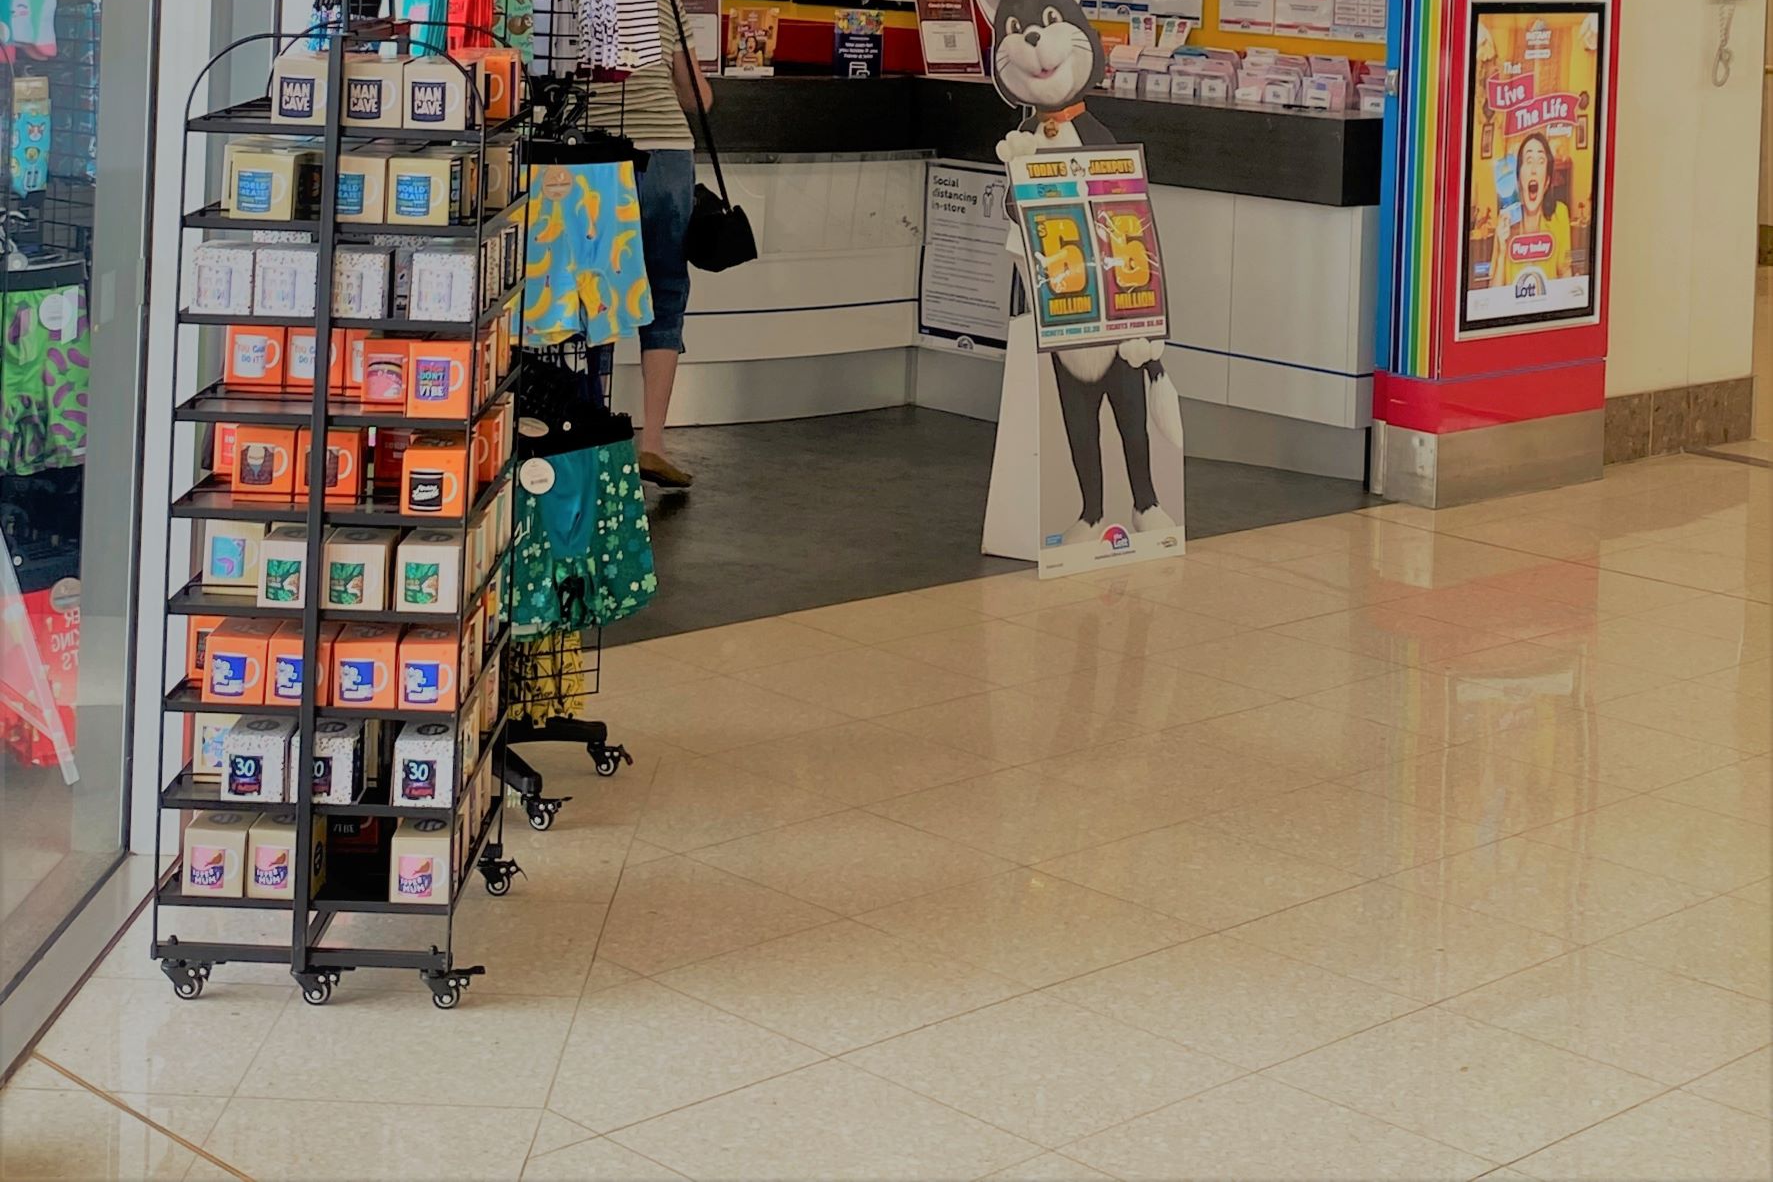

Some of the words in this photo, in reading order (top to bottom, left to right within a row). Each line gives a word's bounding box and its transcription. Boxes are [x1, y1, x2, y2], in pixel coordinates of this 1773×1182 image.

[282, 82, 311, 97] MAN
[350, 84, 379, 98] MAN
[413, 86, 442, 101] MAN
[1496, 84, 1526, 107] Live
[282, 96, 311, 112] CAVE
[350, 97, 379, 114] CAVE
[413, 100, 442, 116] CAVE
[1515, 107, 1540, 131] The
[1542, 97, 1568, 120] Life
[1026, 162, 1068, 178] TODAY'S
[1088, 159, 1135, 176] JACKPOTS
[933, 175, 959, 189] Social
[932, 189, 978, 206] distancing
[1512, 242, 1529, 256] Play
[1049, 296, 1092, 315] MILLION
[1115, 290, 1156, 310] MILLION
[420, 385, 445, 396] VIBE
[235, 757, 256, 777] 30
[408, 761, 429, 781] 30
